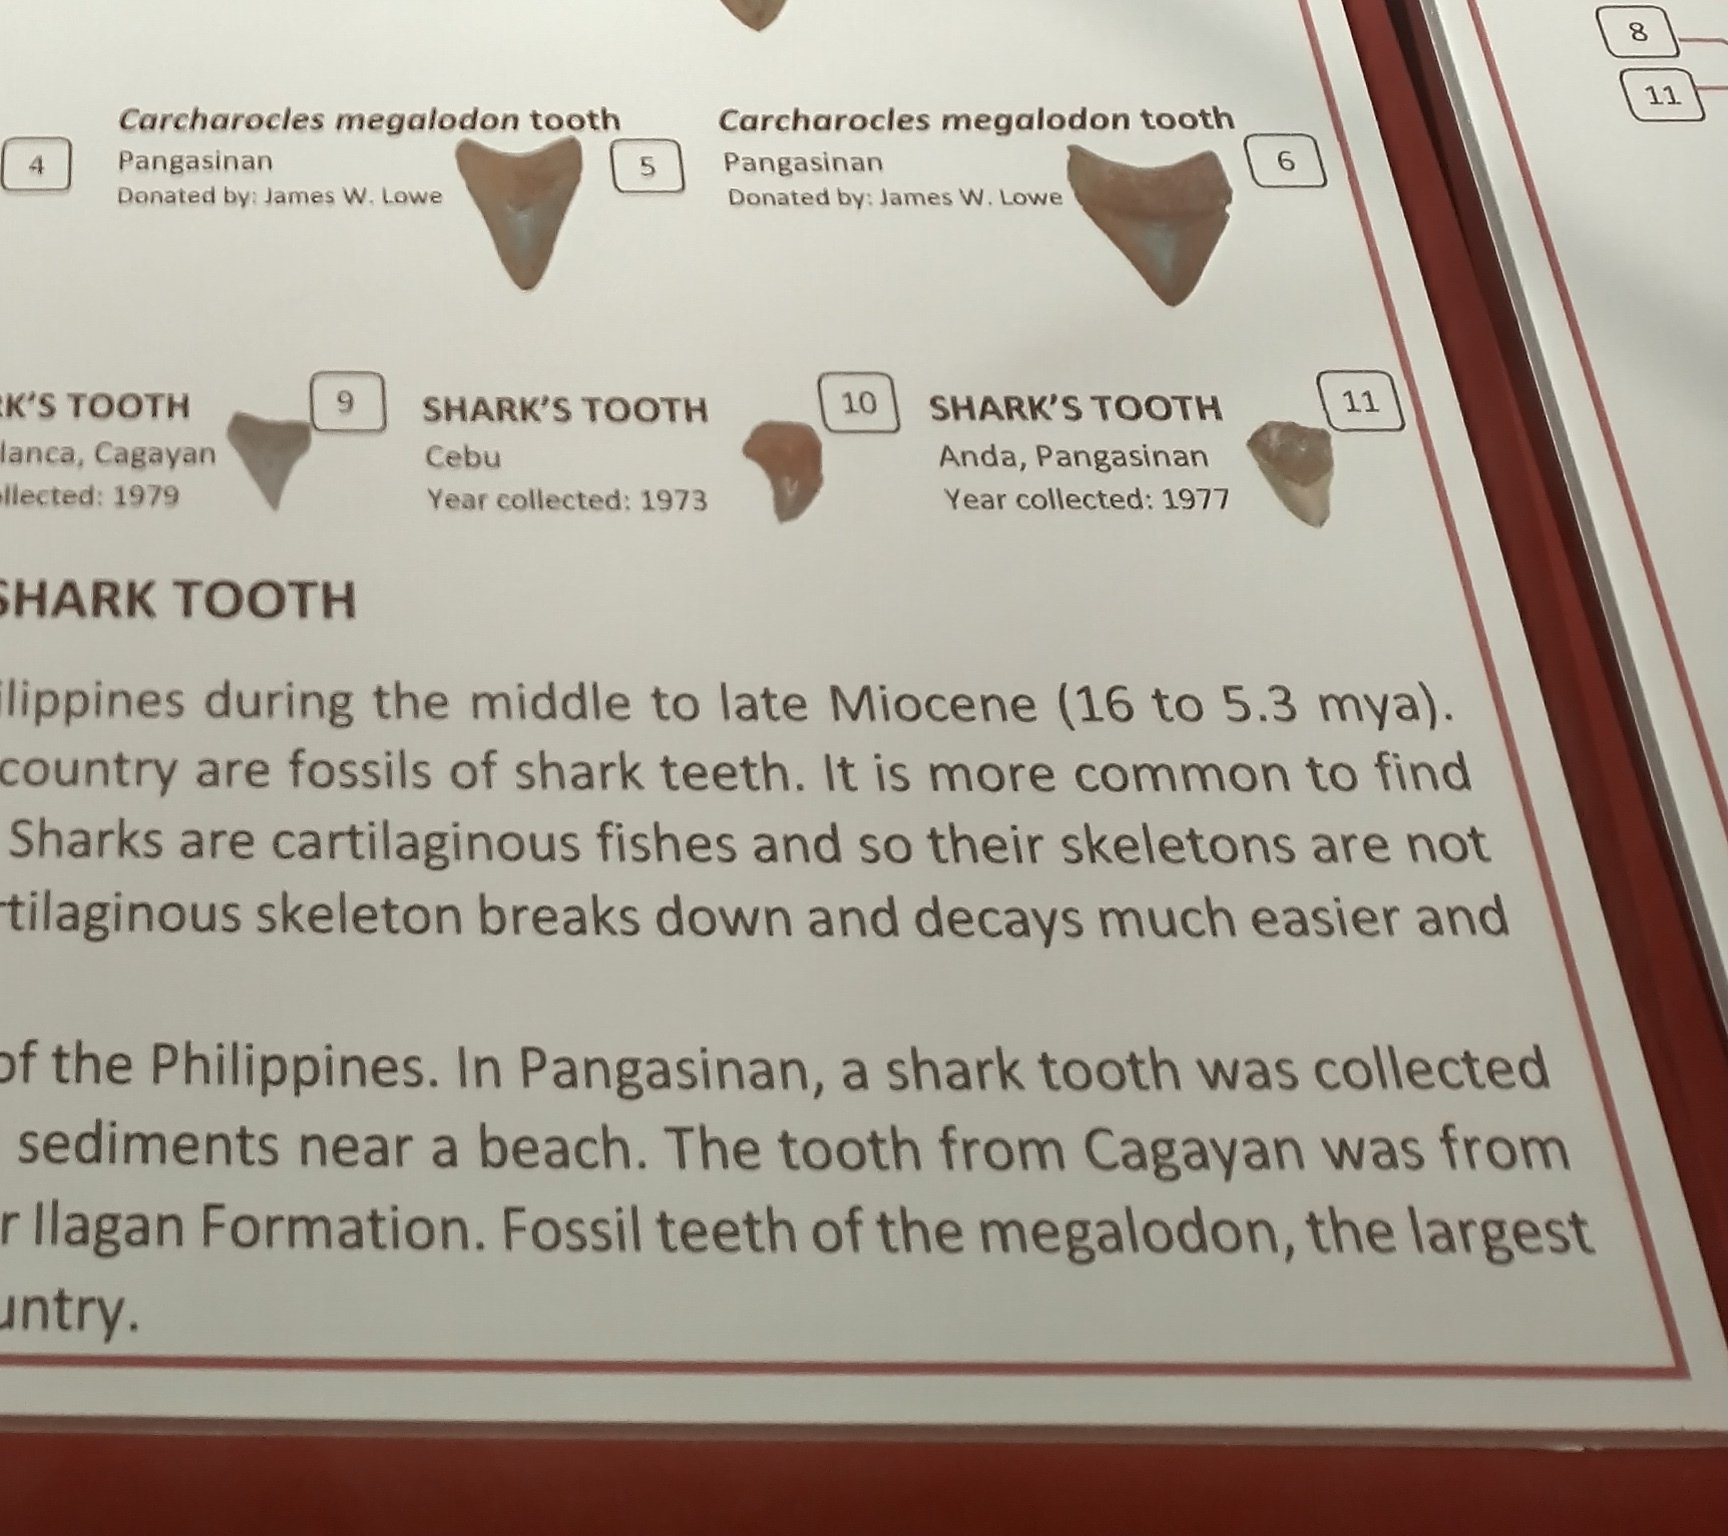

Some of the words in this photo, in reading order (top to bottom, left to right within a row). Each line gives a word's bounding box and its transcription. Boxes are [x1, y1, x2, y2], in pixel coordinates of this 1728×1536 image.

[1628, 21, 1649, 43] 8
[1644, 84, 1683, 106] 11
[118, 106, 325, 133] Carcharocles
[335, 106, 520, 138] megalodon
[529, 106, 621, 133] tooth
[718, 106, 931, 134] Carcharocles
[941, 106, 1130, 138] megalodon
[1139, 105, 1236, 132] tooth
[28, 154, 45, 177] 4
[118, 149, 273, 177] Pangasinan
[639, 155, 657, 179] 5
[723, 150, 884, 178] Pangasinan
[1277, 149, 1296, 173] 6
[117, 184, 216, 206] Donated
[223, 184, 256, 210] by:
[264, 186, 336, 206] James
[342, 186, 374, 206] W.
[381, 186, 443, 206] Lowe
[728, 187, 831, 208] Donated
[836, 187, 873, 212] by:
[879, 187, 954, 208] James
[958, 187, 993, 208] W.
[999, 188, 1063, 207] Lowe
[67, 392, 190, 421] TOOTH
[336, 388, 355, 416] 9
[581, 396, 709, 425] TOOTH
[841, 389, 878, 416] 10
[1089, 394, 1224, 423] TOOTH
[1342, 389, 1380, 414] 11
[94, 440, 216, 473] Cagayan
[425, 442, 502, 470] Cebu
[939, 442, 1027, 473] Anda,
[1035, 442, 1209, 475] Pangasinan
[114, 484, 180, 510] 1979
[427, 487, 488, 512] Year
[496, 487, 631, 513] collected:
[641, 488, 708, 513] 1973
[943, 487, 1007, 512] Year
[1015, 486, 1153, 512] collected:
[1162, 487, 1229, 512] 1977
[172, 578, 356, 621] TOOTH
[204, 678, 355, 731] during
[372, 679, 449, 721] the
[471, 680, 631, 723] middle
[650, 685, 701, 724] to
[720, 681, 808, 723] late
[829, 683, 1038, 724] Miocene
[1058, 681, 1135, 733] (16
[1150, 686, 1204, 724] to
[1222, 683, 1298, 725] 5.3
[1318, 680, 1453, 732] mya).
